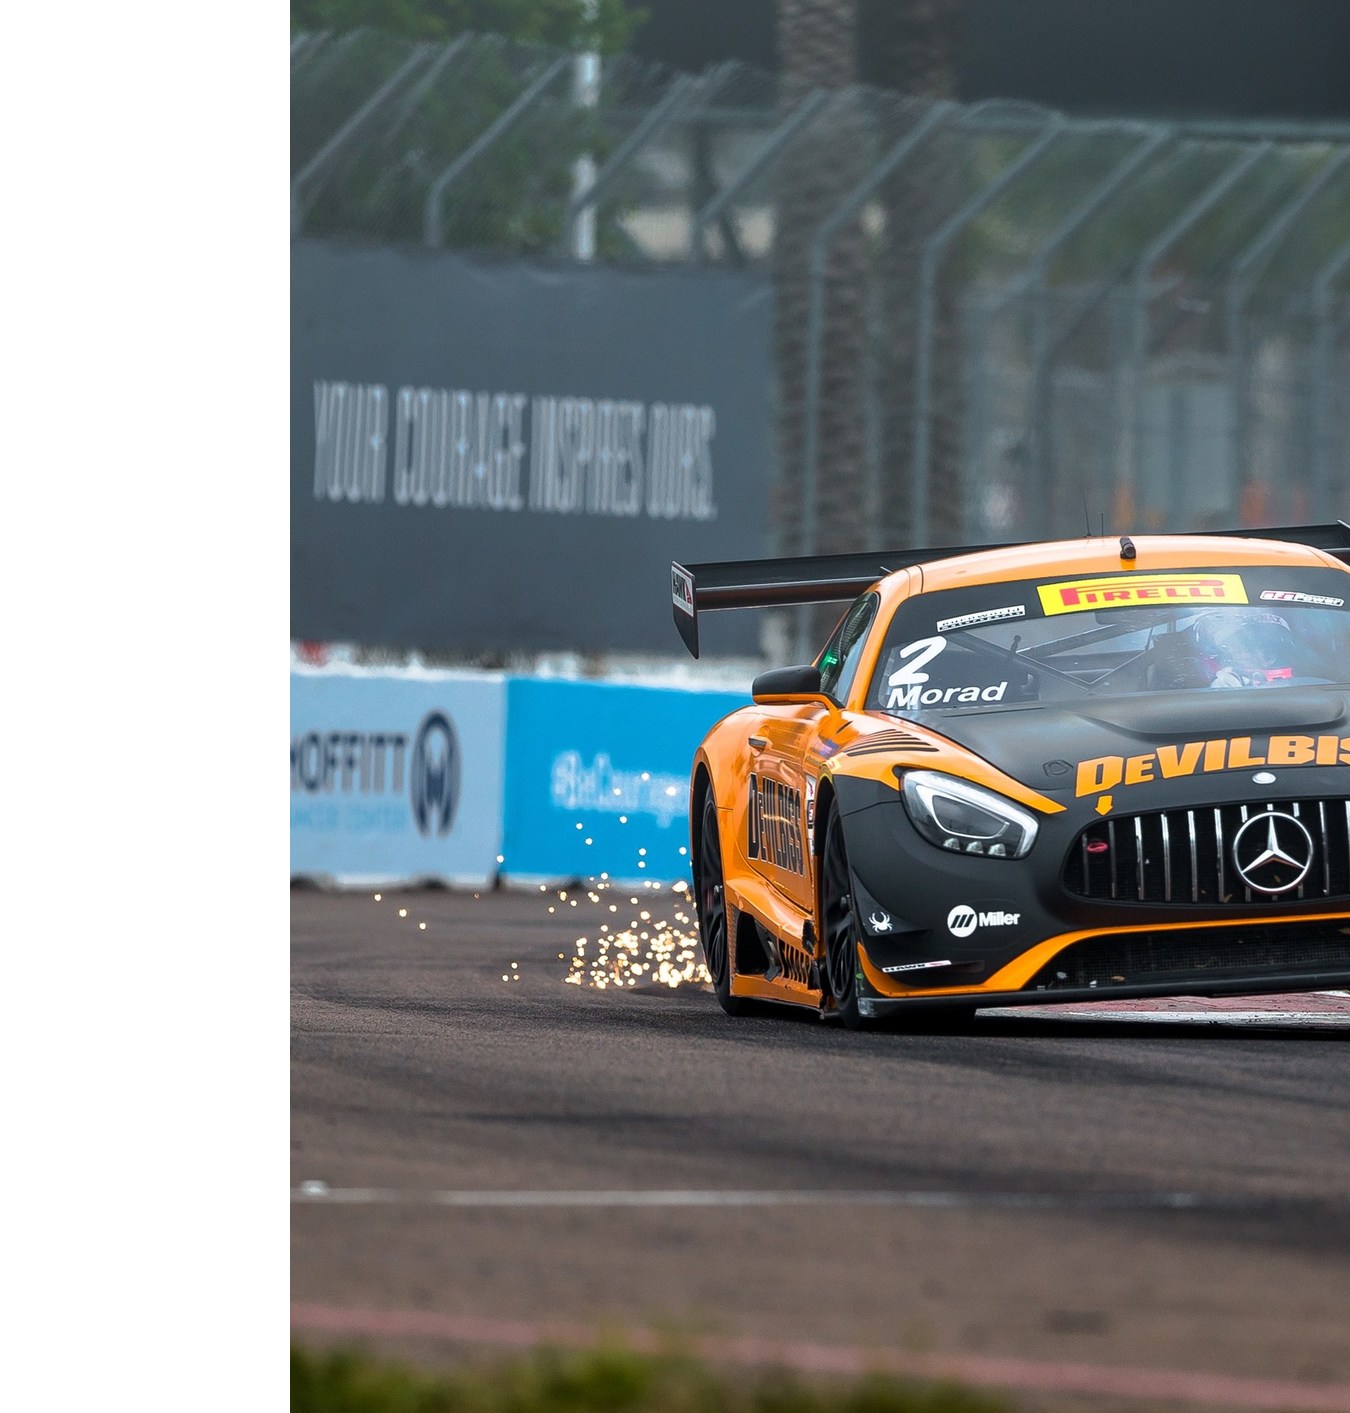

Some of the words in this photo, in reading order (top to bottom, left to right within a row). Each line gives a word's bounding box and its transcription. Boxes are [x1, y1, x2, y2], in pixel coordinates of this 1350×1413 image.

[1060, 580, 1225, 606] PIRELLI
[888, 636, 947, 687] 2
[887, 682, 1008, 709] Morad
[979, 911, 1020, 927] Miller
